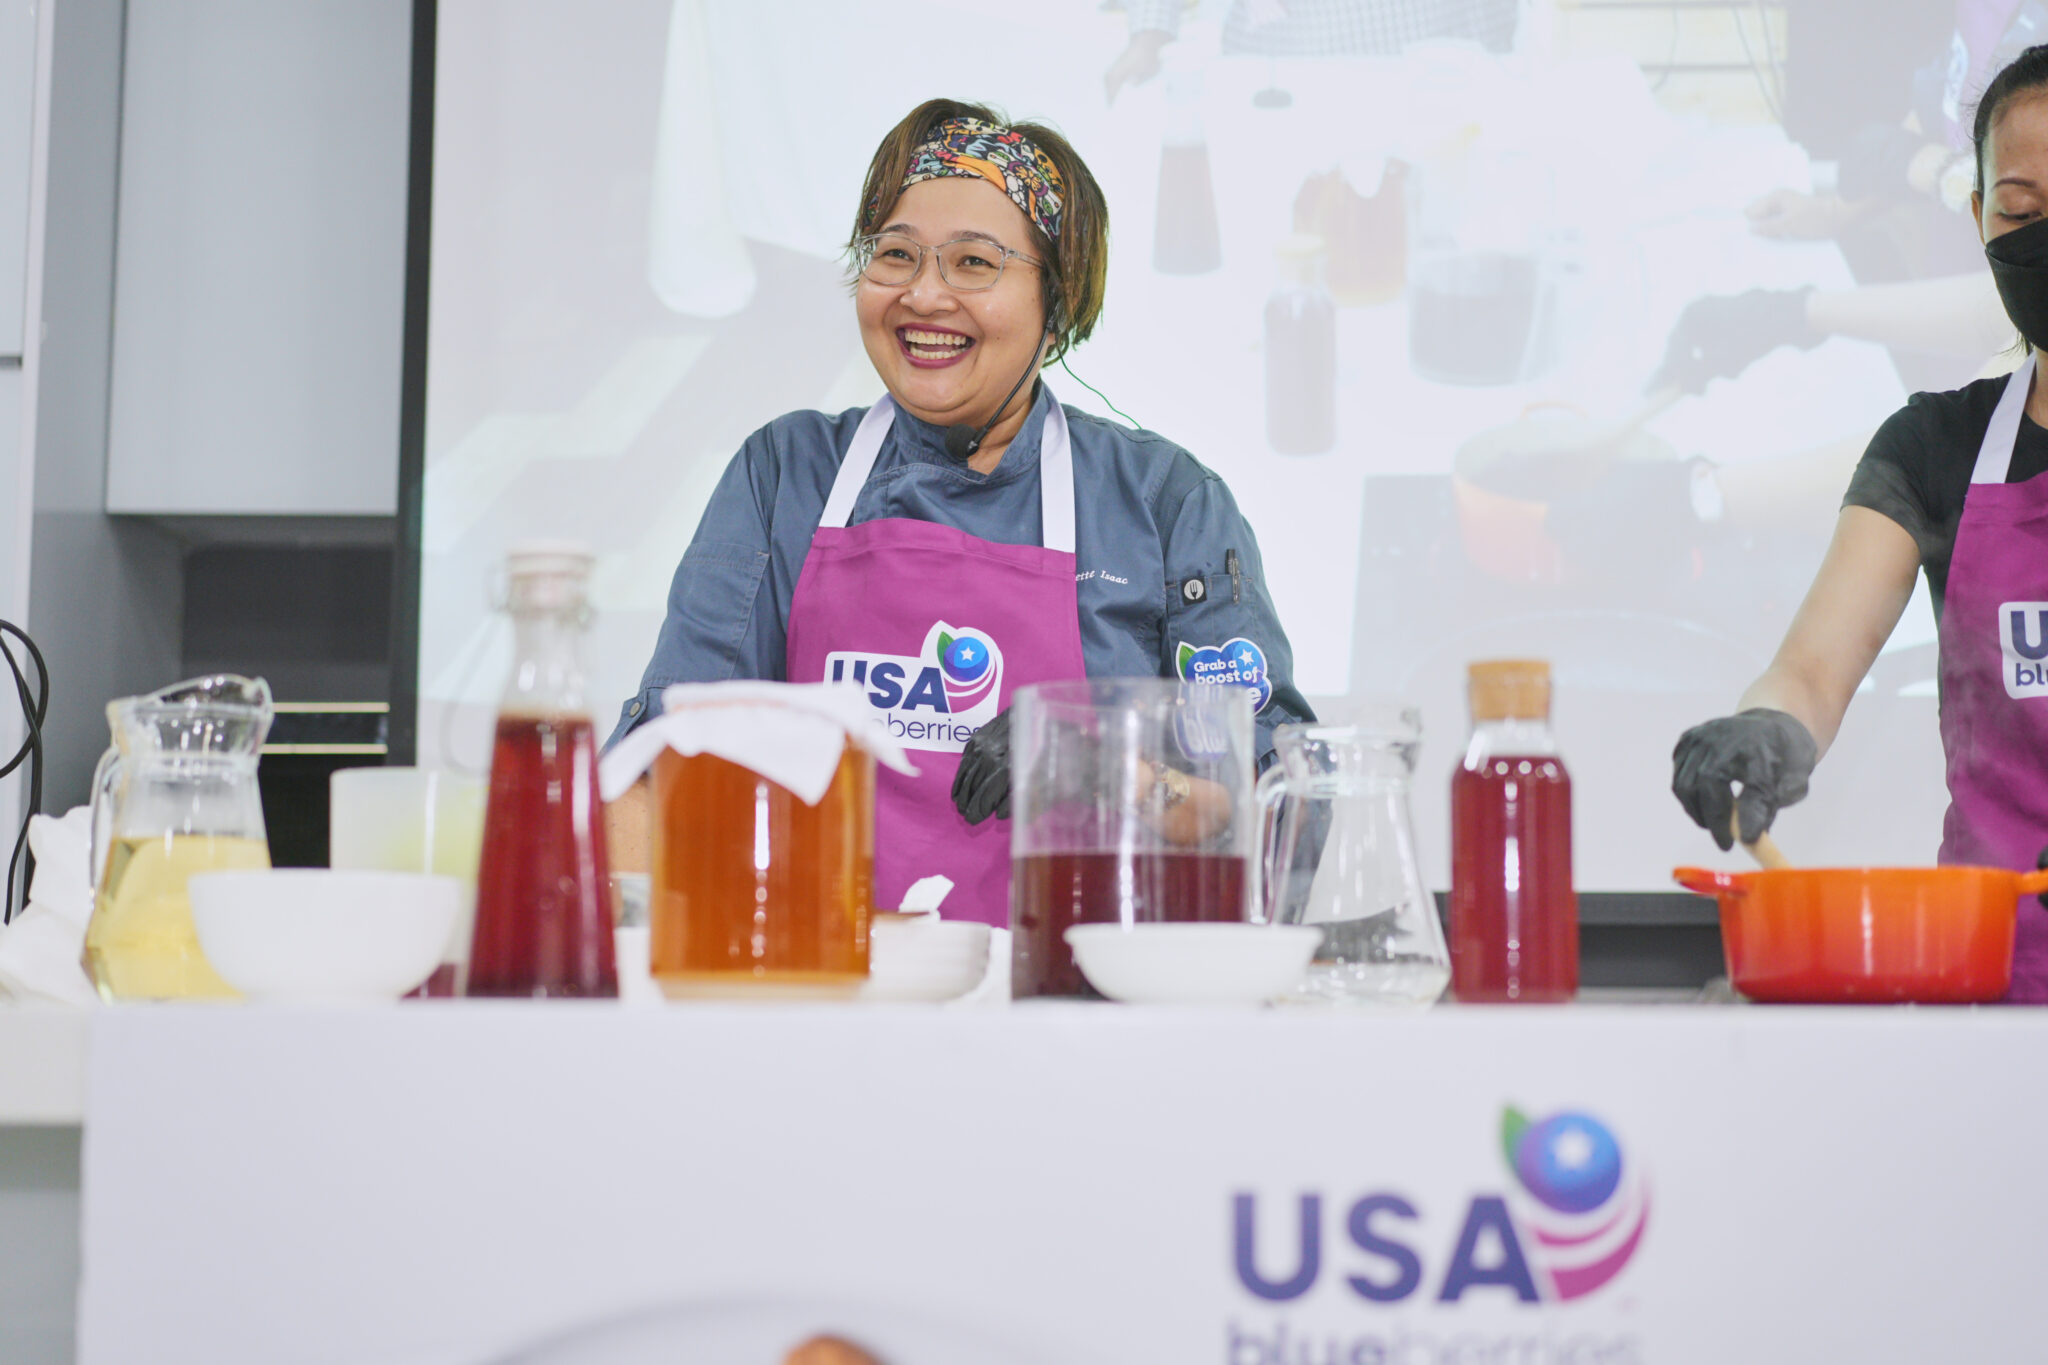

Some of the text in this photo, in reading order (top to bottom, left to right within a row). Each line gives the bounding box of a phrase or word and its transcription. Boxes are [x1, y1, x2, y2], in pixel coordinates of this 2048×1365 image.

[1100, 570, 1128, 584] Isaac
[1194, 659, 1238, 673] Grab a
[1195, 666, 1259, 685] boost of
[1231, 1193, 1540, 1303] USA
